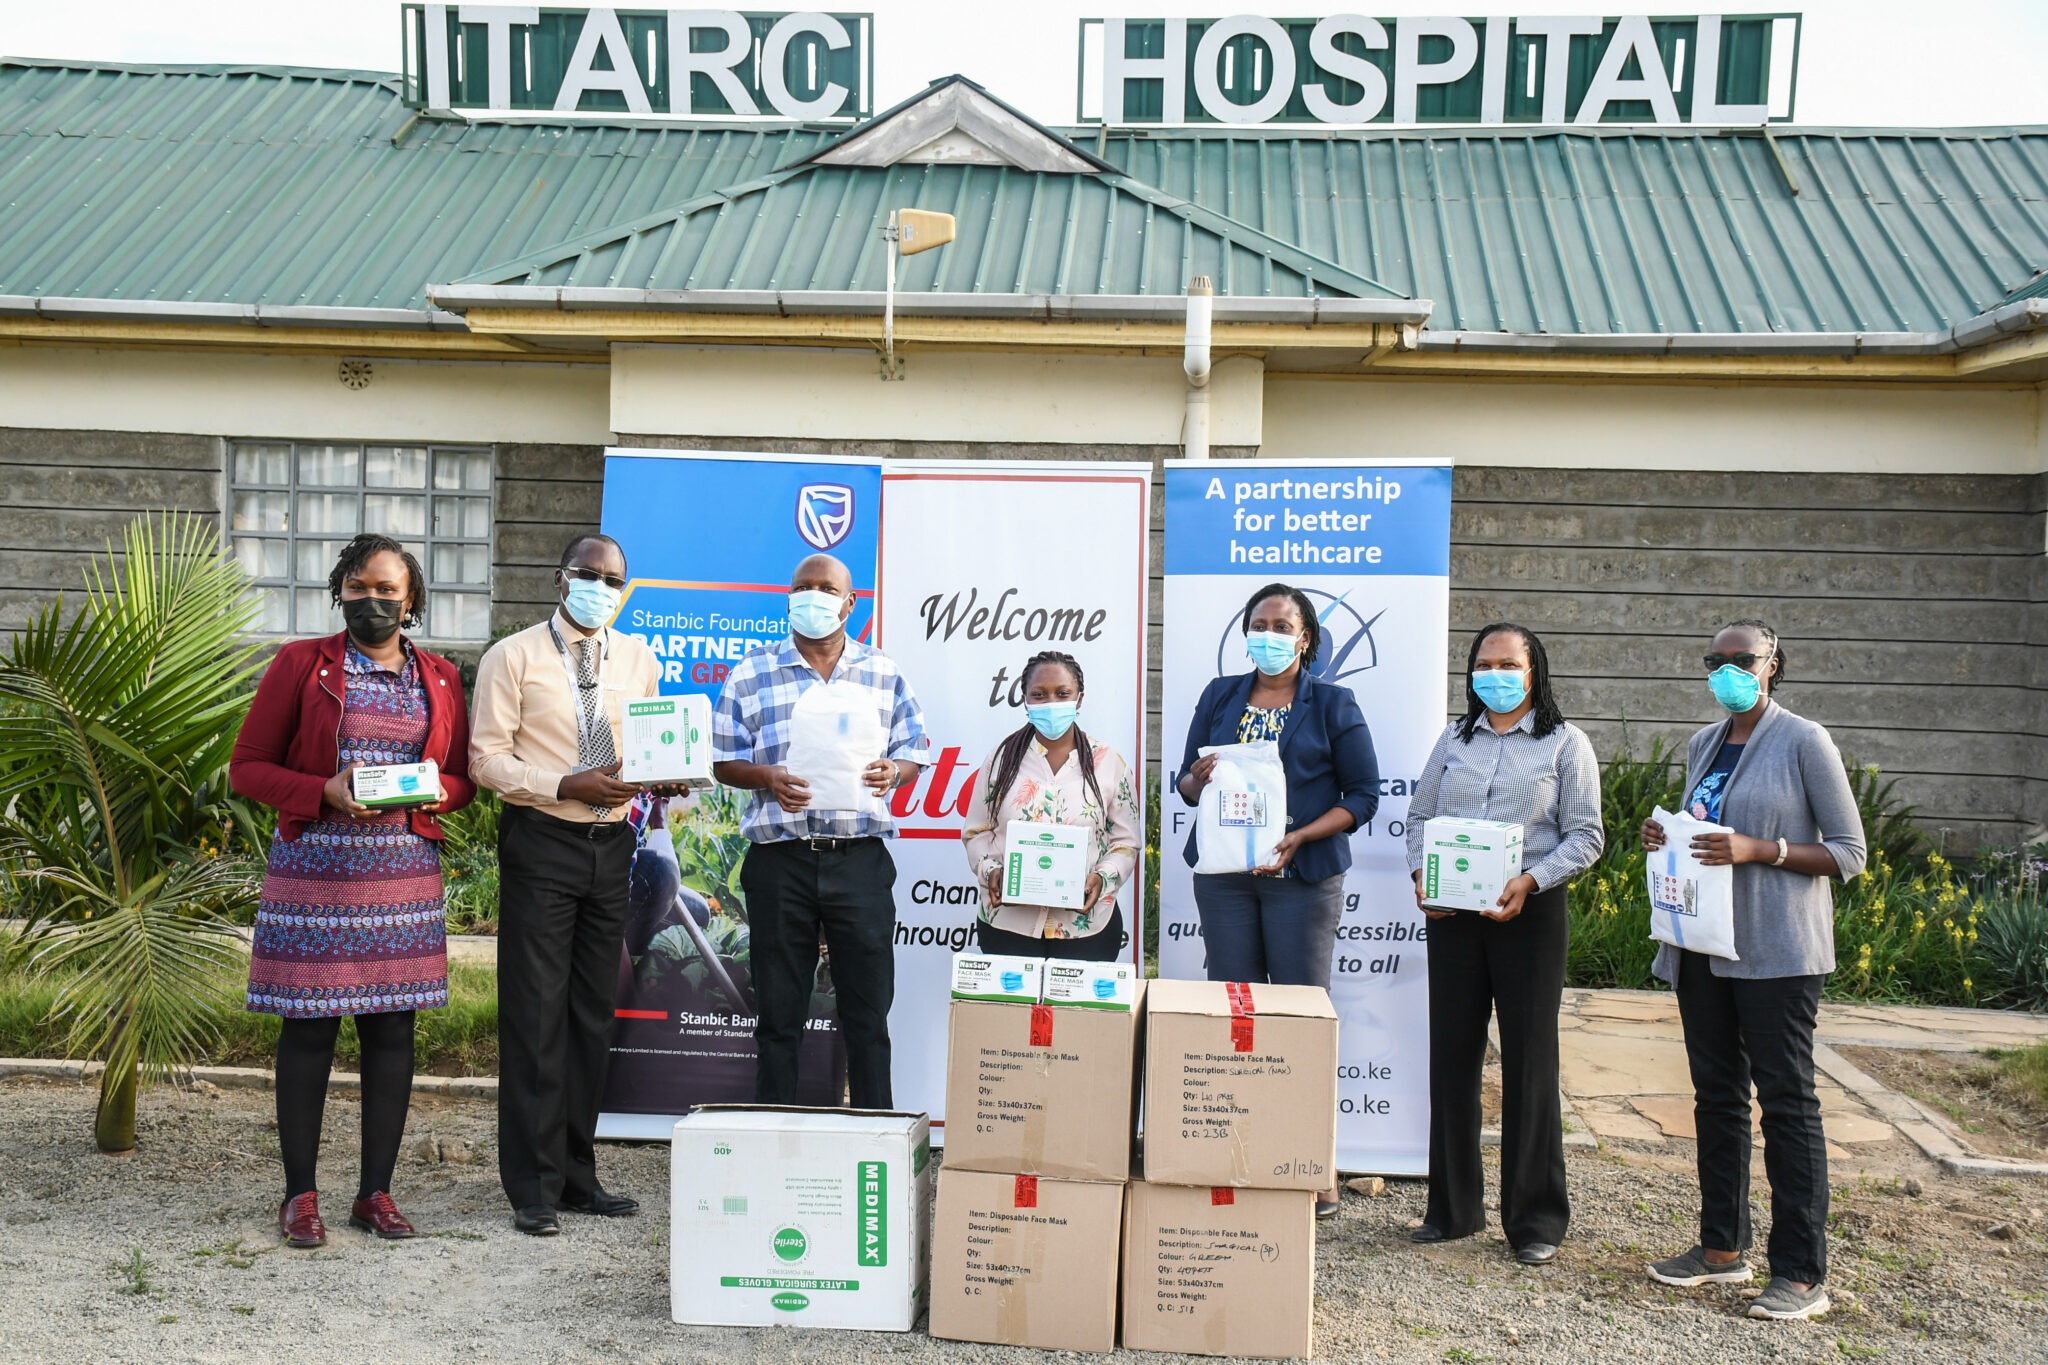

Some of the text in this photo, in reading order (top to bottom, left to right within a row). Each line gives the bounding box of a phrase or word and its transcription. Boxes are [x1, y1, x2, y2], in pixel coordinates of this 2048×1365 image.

[425, 4, 1769, 125] ITARC HOSPITAL
[1205, 476, 1401, 503] A partnership
[1233, 508, 1372, 532] for better
[1230, 540, 1382, 564] healthcare
[919, 587, 1107, 643] Welcome
[632, 609, 791, 635] Stanbic Foundati
[989, 666, 1024, 707] to
[630, 704, 672, 713] MEDIMAX
[1010, 855, 1020, 896] MEDIMAX
[1429, 856, 1437, 898] MEDIMAX
[911, 880, 981, 905] Chan
[1335, 922, 1428, 942] cessible
[959, 960, 989, 970] NaxSafe
[1338, 954, 1400, 973] to all
[1051, 967, 1081, 977] NaxSafe
[680, 1011, 728, 1026] Stanbic
[686, 1028, 713, 1036] member
[724, 1030, 753, 1038] Standard
[980, 1048, 999, 1056] Item:
[1001, 1049, 1040, 1059] Disposabe
[1060, 1053, 1079, 1061] Mask
[1205, 1053, 1245, 1062] Disposable
[1247, 1055, 1263, 1063] Face
[1266, 1055, 1284, 1063] Mask
[980, 1061, 1023, 1070] Description:
[1184, 1066, 1227, 1075] Description:
[1337, 1061, 1391, 1080] co.ke
[979, 1074, 1005, 1082] Colour:
[978, 1087, 993, 1095] Qty:
[1183, 1092, 1198, 1100] Qty:
[998, 1100, 1042, 1110] 53x40x37cm
[1183, 1104, 1249, 1114] Size: 53x40x37cm
[1337, 1094, 1391, 1115] o.ke
[999, 1113, 1026, 1123] Weight:
[1182, 1117, 1232, 1127] Gross Weight:
[714, 1147, 732, 1155] 400
[865, 1164, 878, 1259] MEDIMAX
[969, 1210, 1067, 1225] Item: Disposable Face Mask
[968, 1222, 1011, 1233] Description:
[1221, 1229, 1238, 1237] Face
[1240, 1230, 1259, 1238] Mask
[775, 1238, 804, 1247] Sterile
[967, 1236, 993, 1244] Colour:
[1158, 1239, 1202, 1249] Description:
[966, 1248, 981, 1258] Qty:
[1158, 1252, 1185, 1261] Colour:
[966, 1261, 1031, 1274] Size: 53x40x37cm
[1158, 1265, 1173, 1274] Qty:
[738, 1278, 846, 1289] LATEX SURGICAL GLOVES
[965, 1274, 1014, 1286] Gross Weight:
[1158, 1278, 1223, 1288] Size: 53x40x37cm
[974, 1287, 982, 1295] C:
[1157, 1291, 1207, 1301] Gross Weight:
